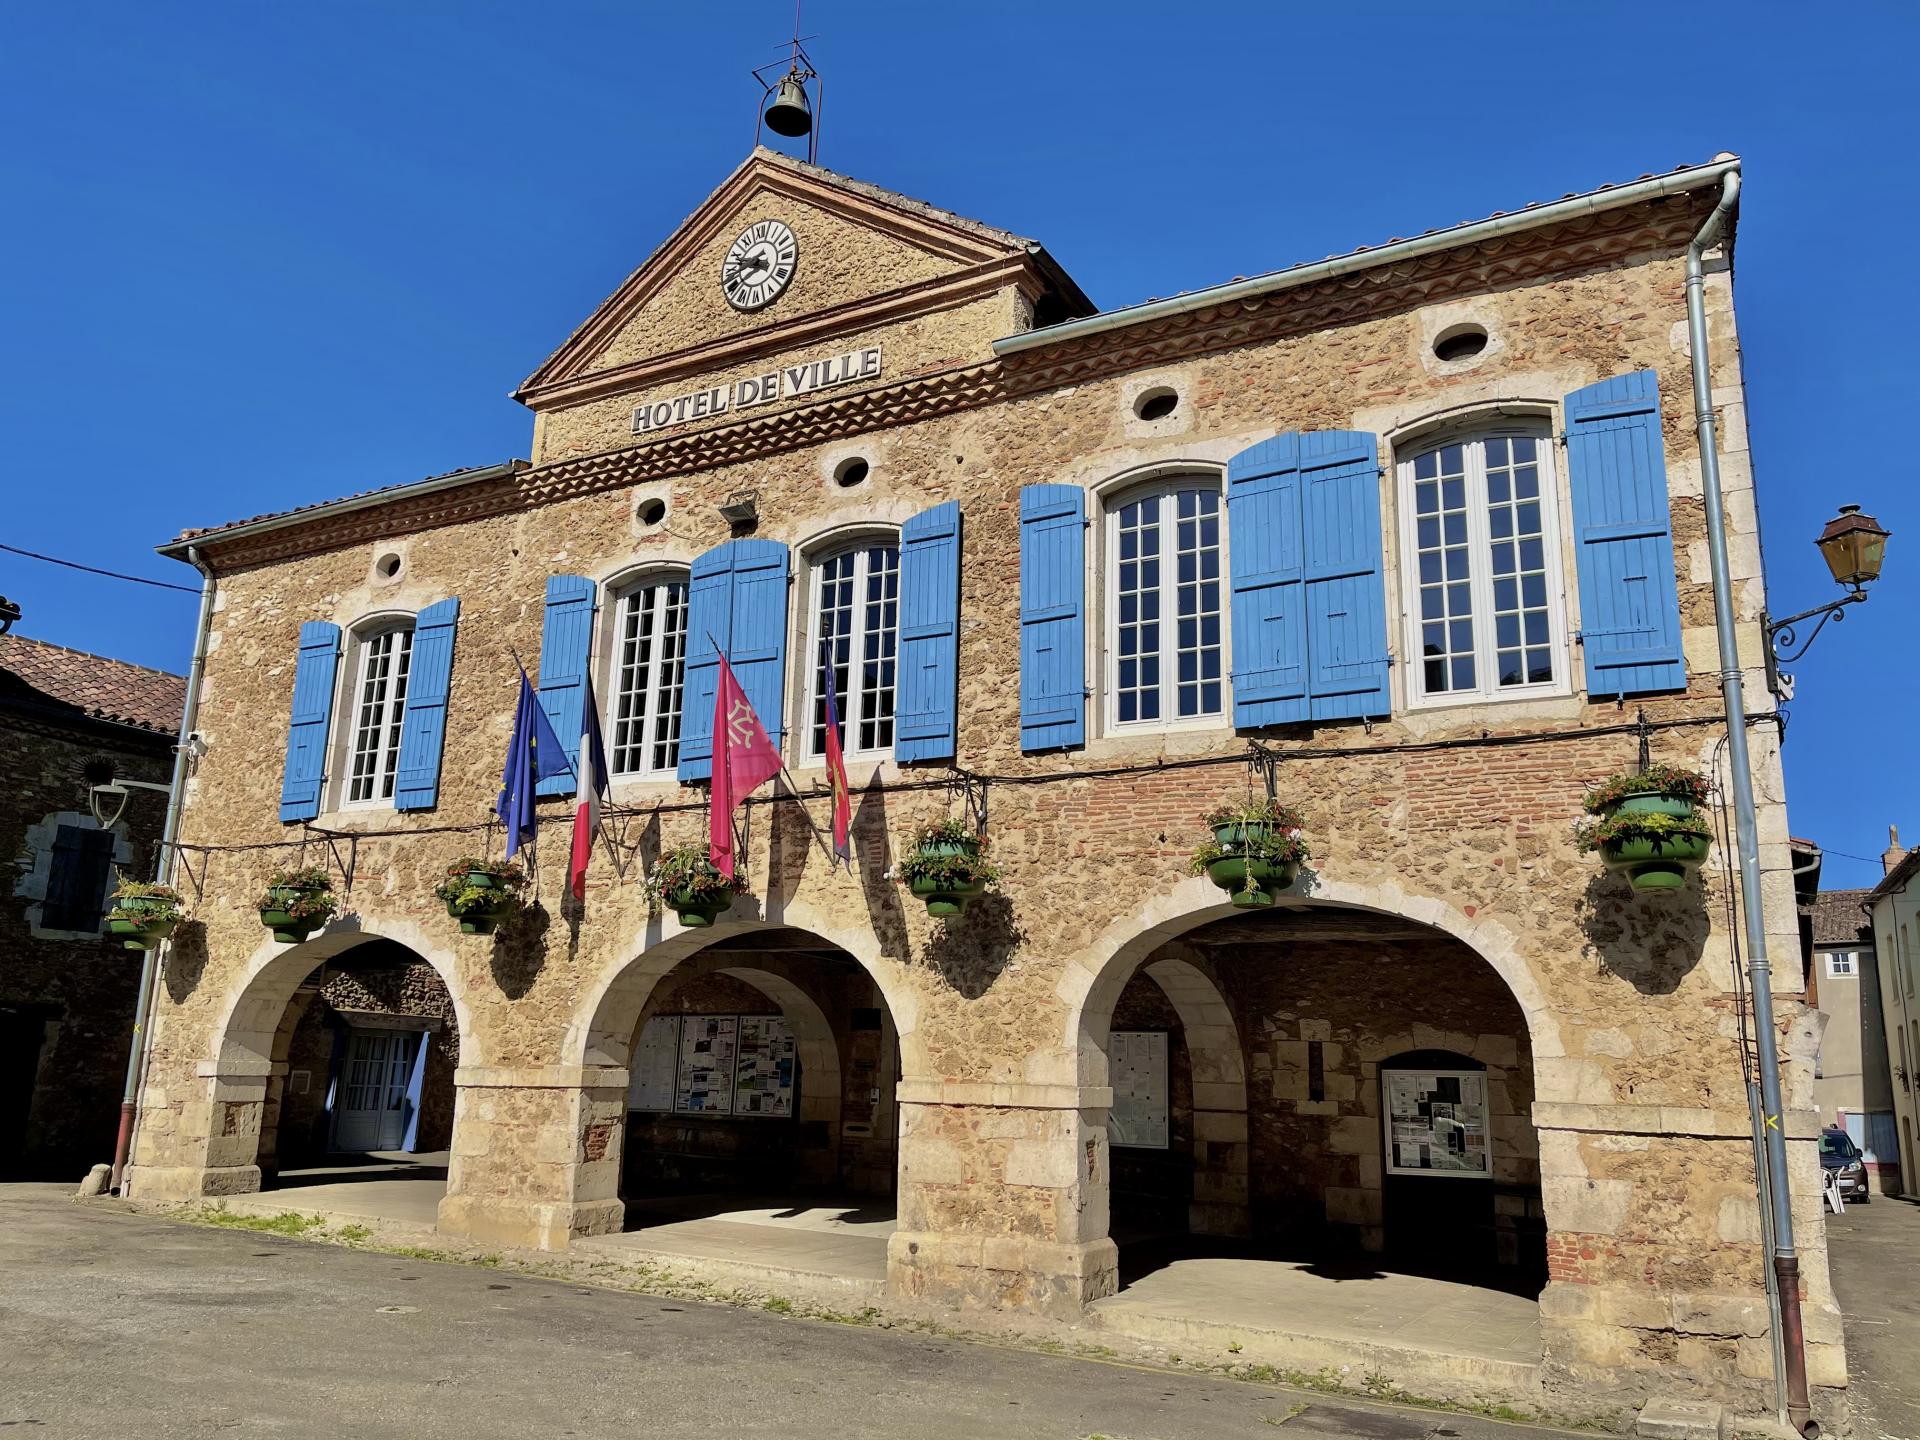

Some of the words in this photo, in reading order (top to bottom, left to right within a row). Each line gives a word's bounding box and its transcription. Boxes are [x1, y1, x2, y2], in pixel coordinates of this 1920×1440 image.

[632, 388, 727, 432] HOTEL
[736, 373, 779, 405] DE
[787, 348, 880, 392] VILLE
